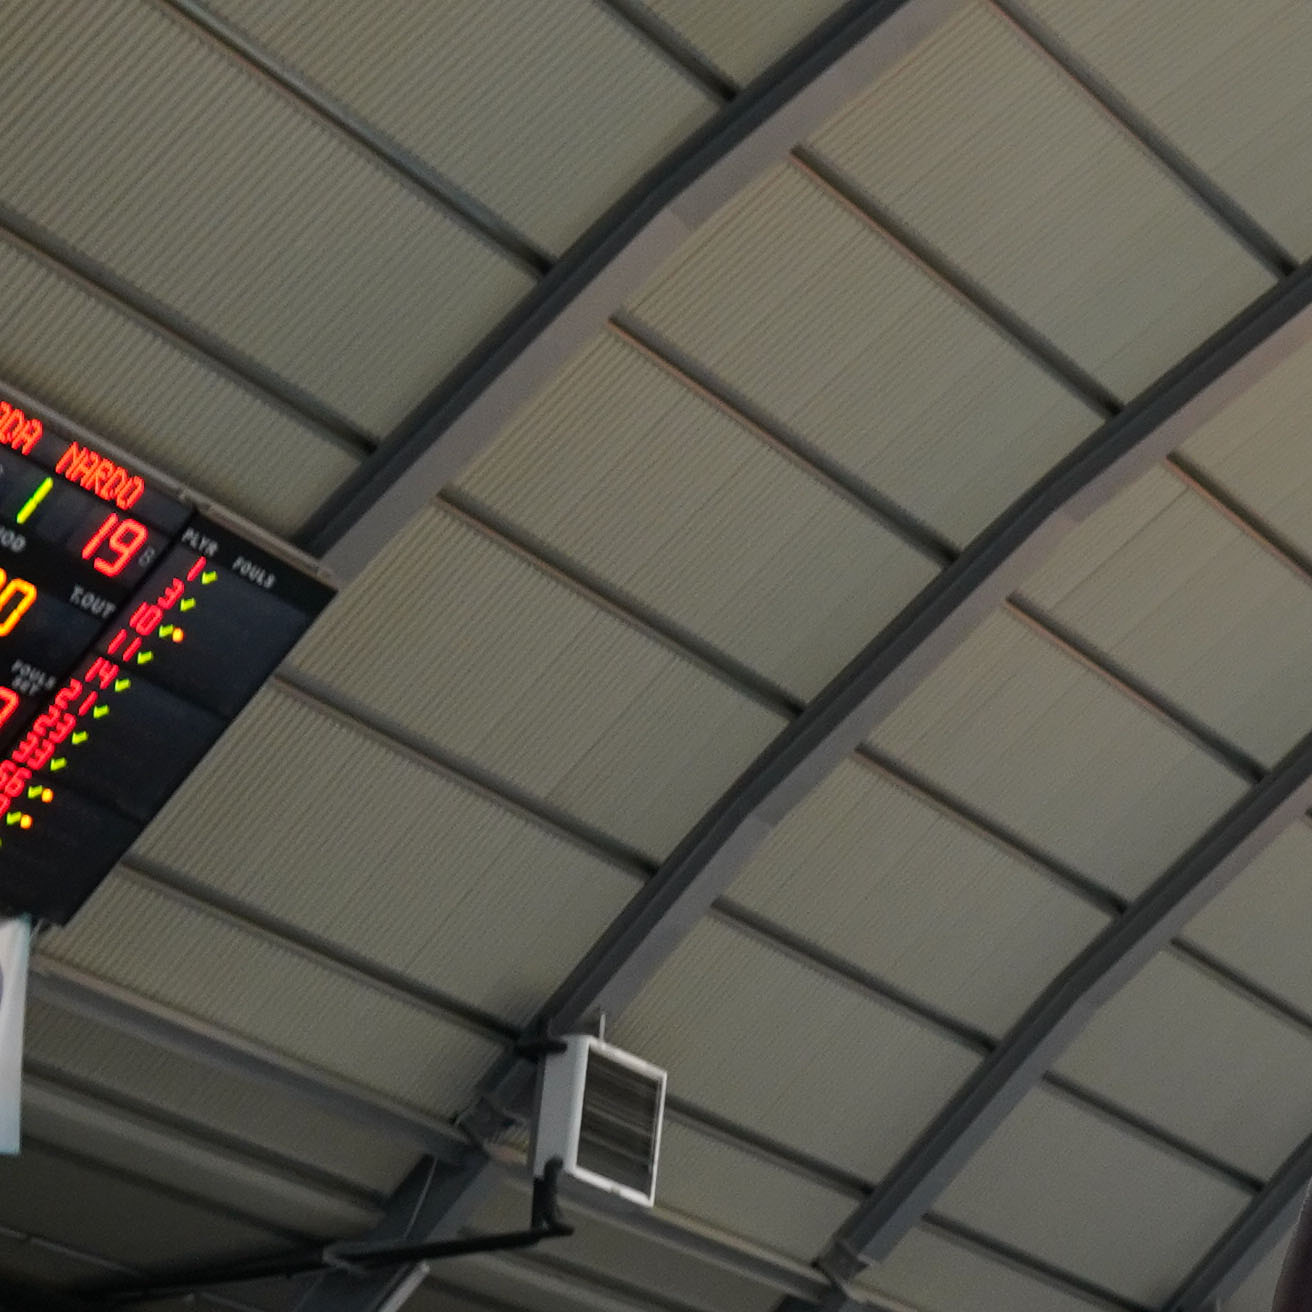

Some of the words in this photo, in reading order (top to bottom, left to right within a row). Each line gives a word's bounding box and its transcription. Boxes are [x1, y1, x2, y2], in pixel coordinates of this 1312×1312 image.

[55, 441, 145, 510] NARDO
[16, 477, 54, 525] 1
[82, 513, 149, 577] 19
[157, 578, 185, 609] 3
[129, 602, 164, 636] 10
